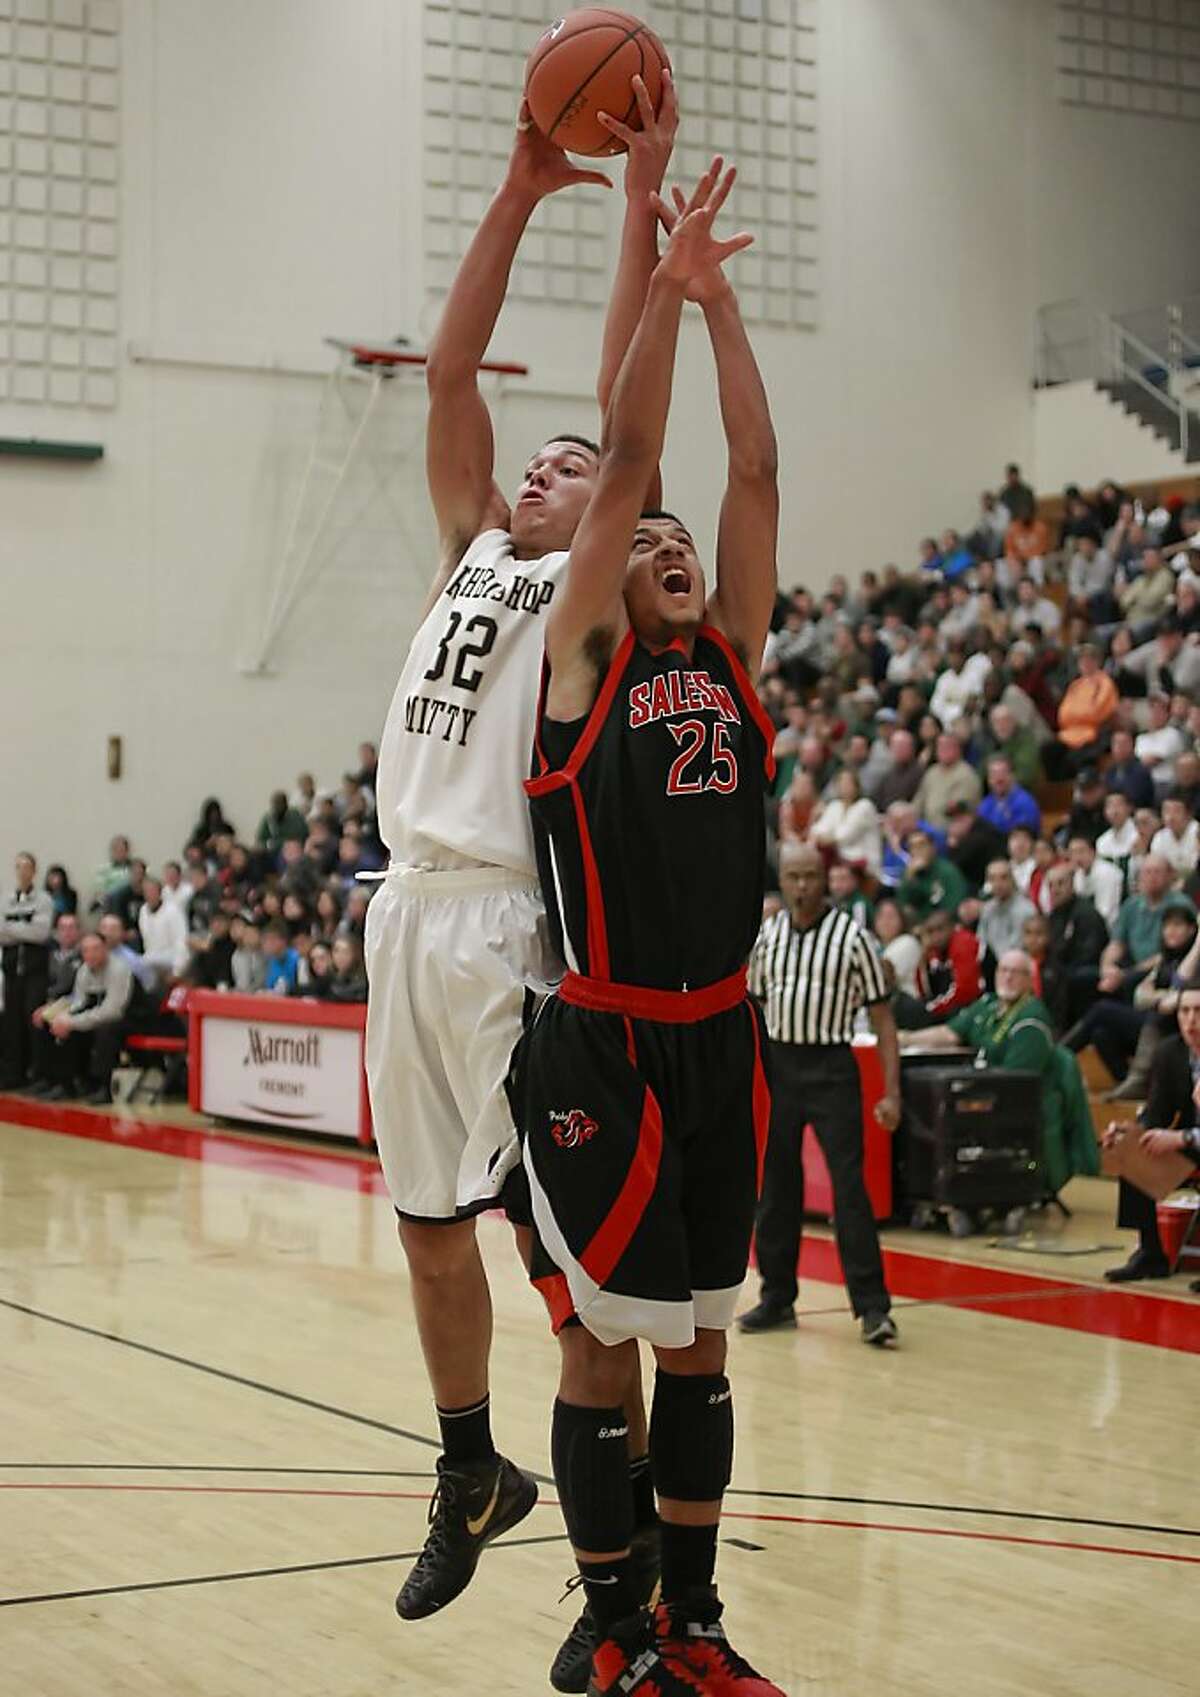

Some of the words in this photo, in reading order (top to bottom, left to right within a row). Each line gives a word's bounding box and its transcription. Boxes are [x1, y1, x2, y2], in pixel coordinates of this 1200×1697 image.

[424, 611, 498, 692] 32
[665, 719, 738, 796] 25
[243, 1026, 320, 1068] Marriott
